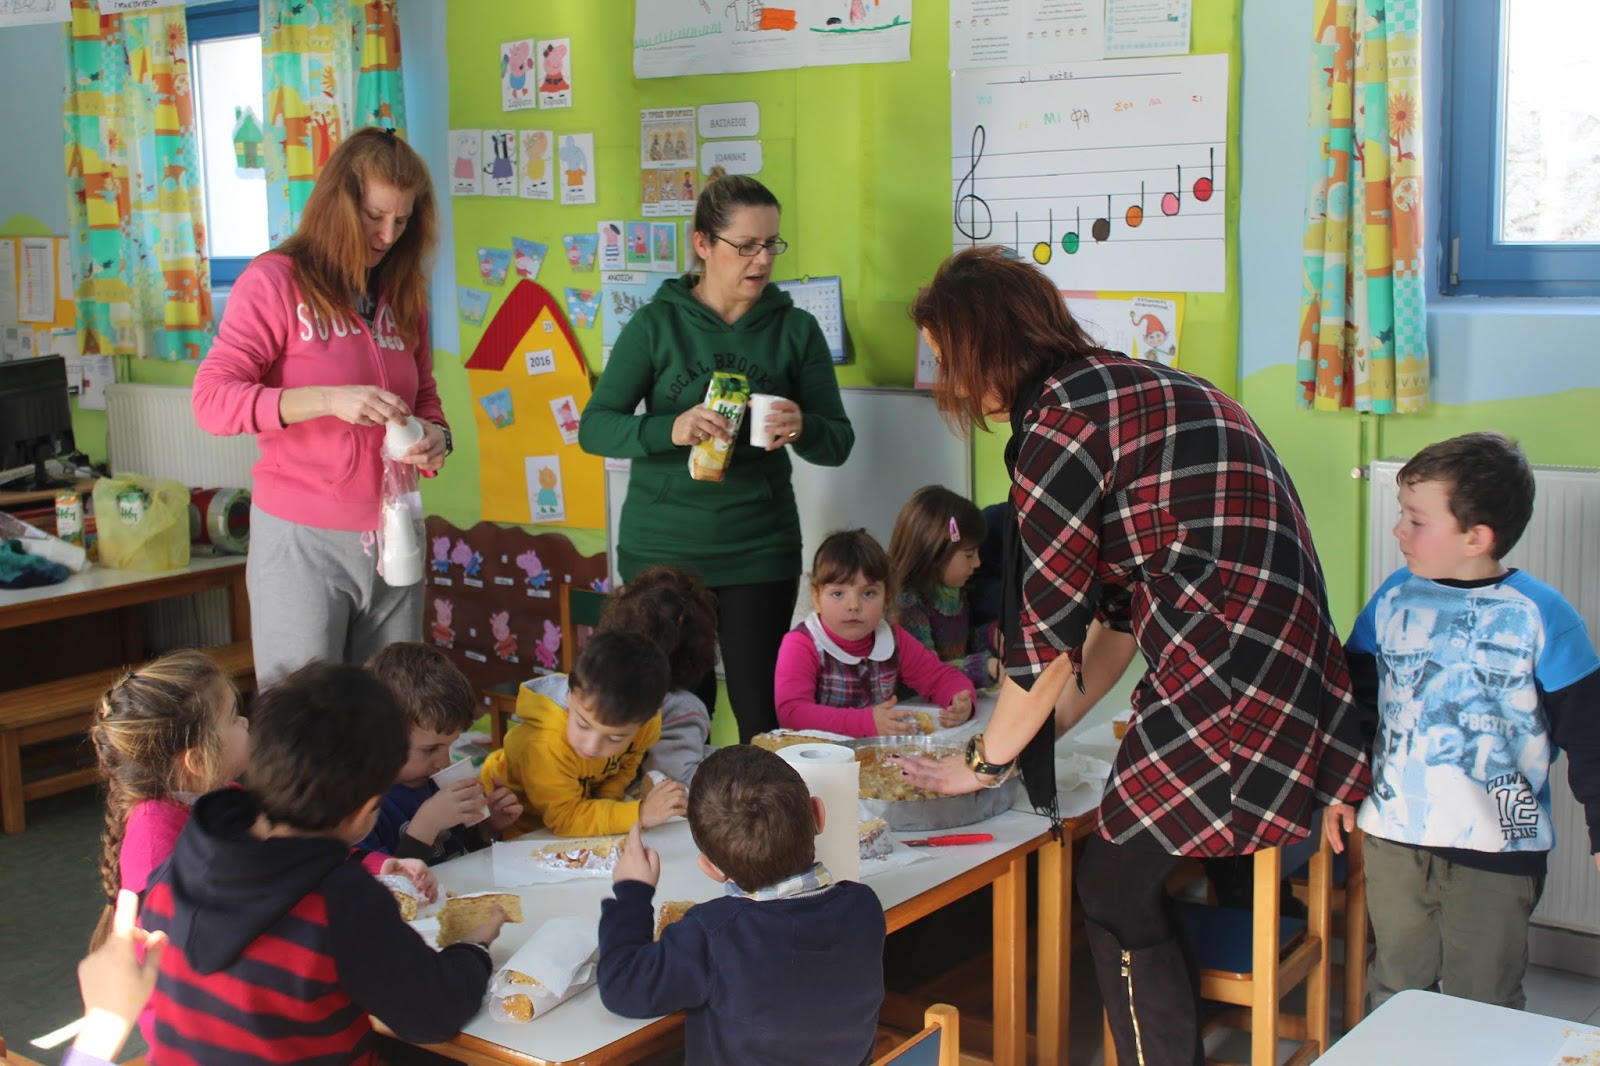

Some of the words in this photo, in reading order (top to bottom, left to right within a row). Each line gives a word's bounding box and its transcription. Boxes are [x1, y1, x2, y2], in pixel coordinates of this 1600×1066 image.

[530, 356, 551, 368] 2016
[666, 360, 710, 404] LOCAL
[1496, 788, 1539, 828] 12
[1501, 827, 1538, 840] TEXAS
